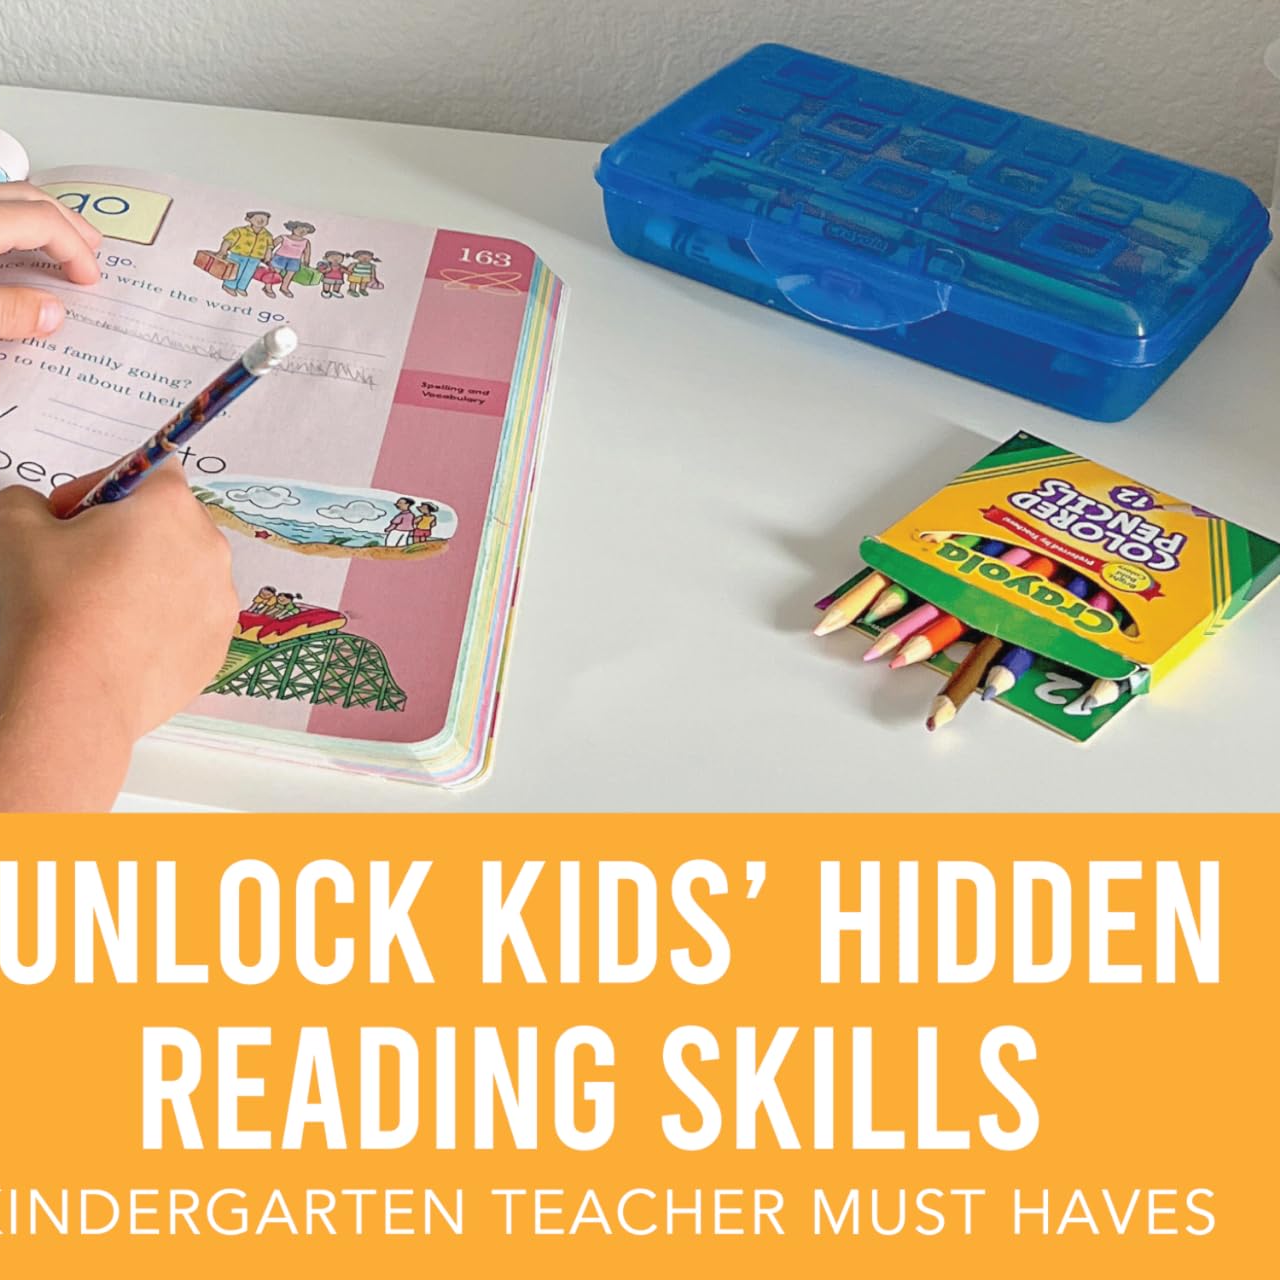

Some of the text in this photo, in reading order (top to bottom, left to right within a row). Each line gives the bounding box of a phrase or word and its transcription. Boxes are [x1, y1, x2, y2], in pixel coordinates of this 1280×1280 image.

[458, 247, 512, 268] 163
[113, 273, 290, 324] write the word go.
[14, 354, 33, 366] to
[39, 359, 74, 377] tell
[77, 371, 132, 396] about
[139, 389, 185, 410] their
[21, 337, 57, 353] this
[63, 344, 124, 370] family
[128, 365, 193, 389] going?
[421, 382, 464, 393] Spelling
[421, 390, 486, 405] Vocabulary
[178, 446, 226, 474] to
[1040, 480, 1184, 552] PENCILS
[1116, 488, 1149, 507] 12
[1011, 492, 1177, 571] COLORED
[935, 542, 1114, 634] Crayola
